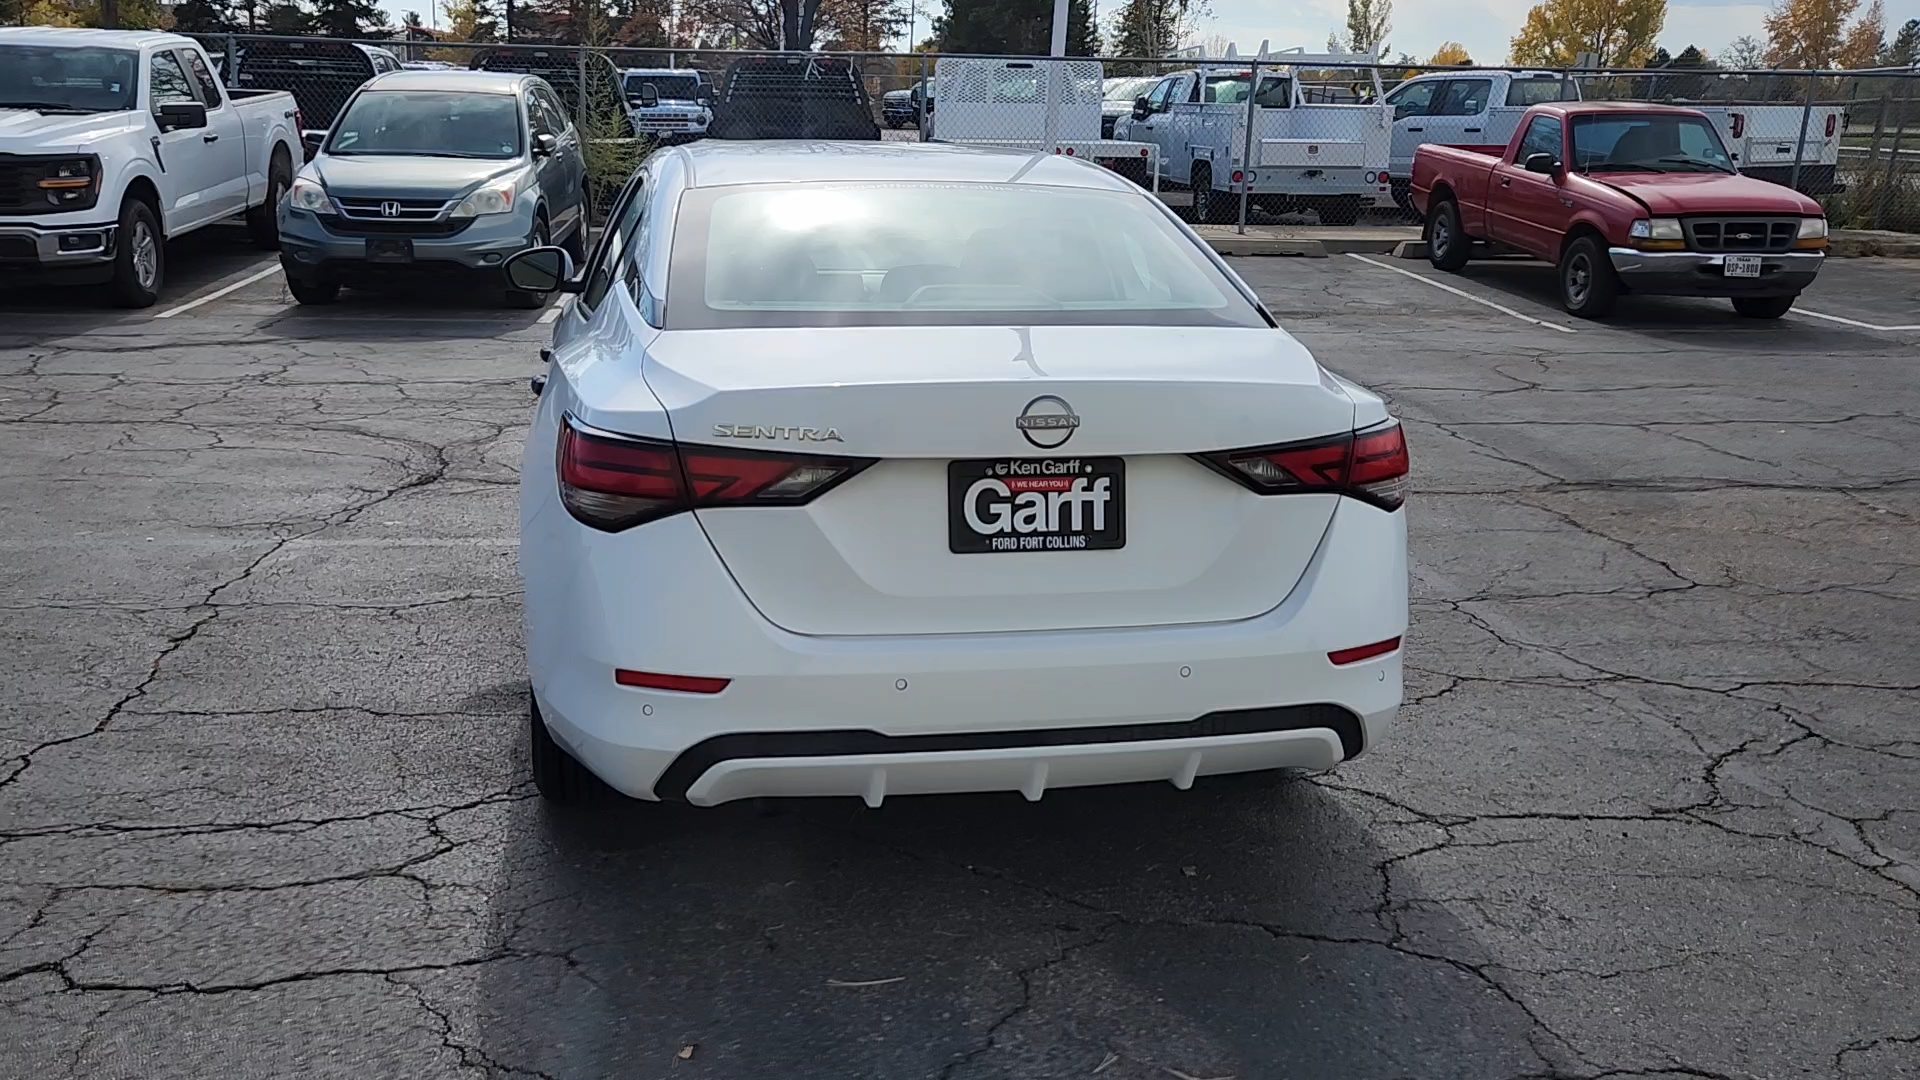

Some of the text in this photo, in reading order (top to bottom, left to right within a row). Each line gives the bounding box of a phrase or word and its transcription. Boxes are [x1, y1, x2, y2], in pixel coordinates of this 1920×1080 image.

[1018, 417, 1079, 427] NISSAN
[713, 423, 845, 442] SENTRA
[1010, 459, 1080, 475] Ken Garff
[1029, 480, 1048, 488] HEAR
[1049, 479, 1064, 487] YOU
[964, 478, 1110, 534] Garff
[992, 535, 1086, 550] FORD FORT COLLINS
